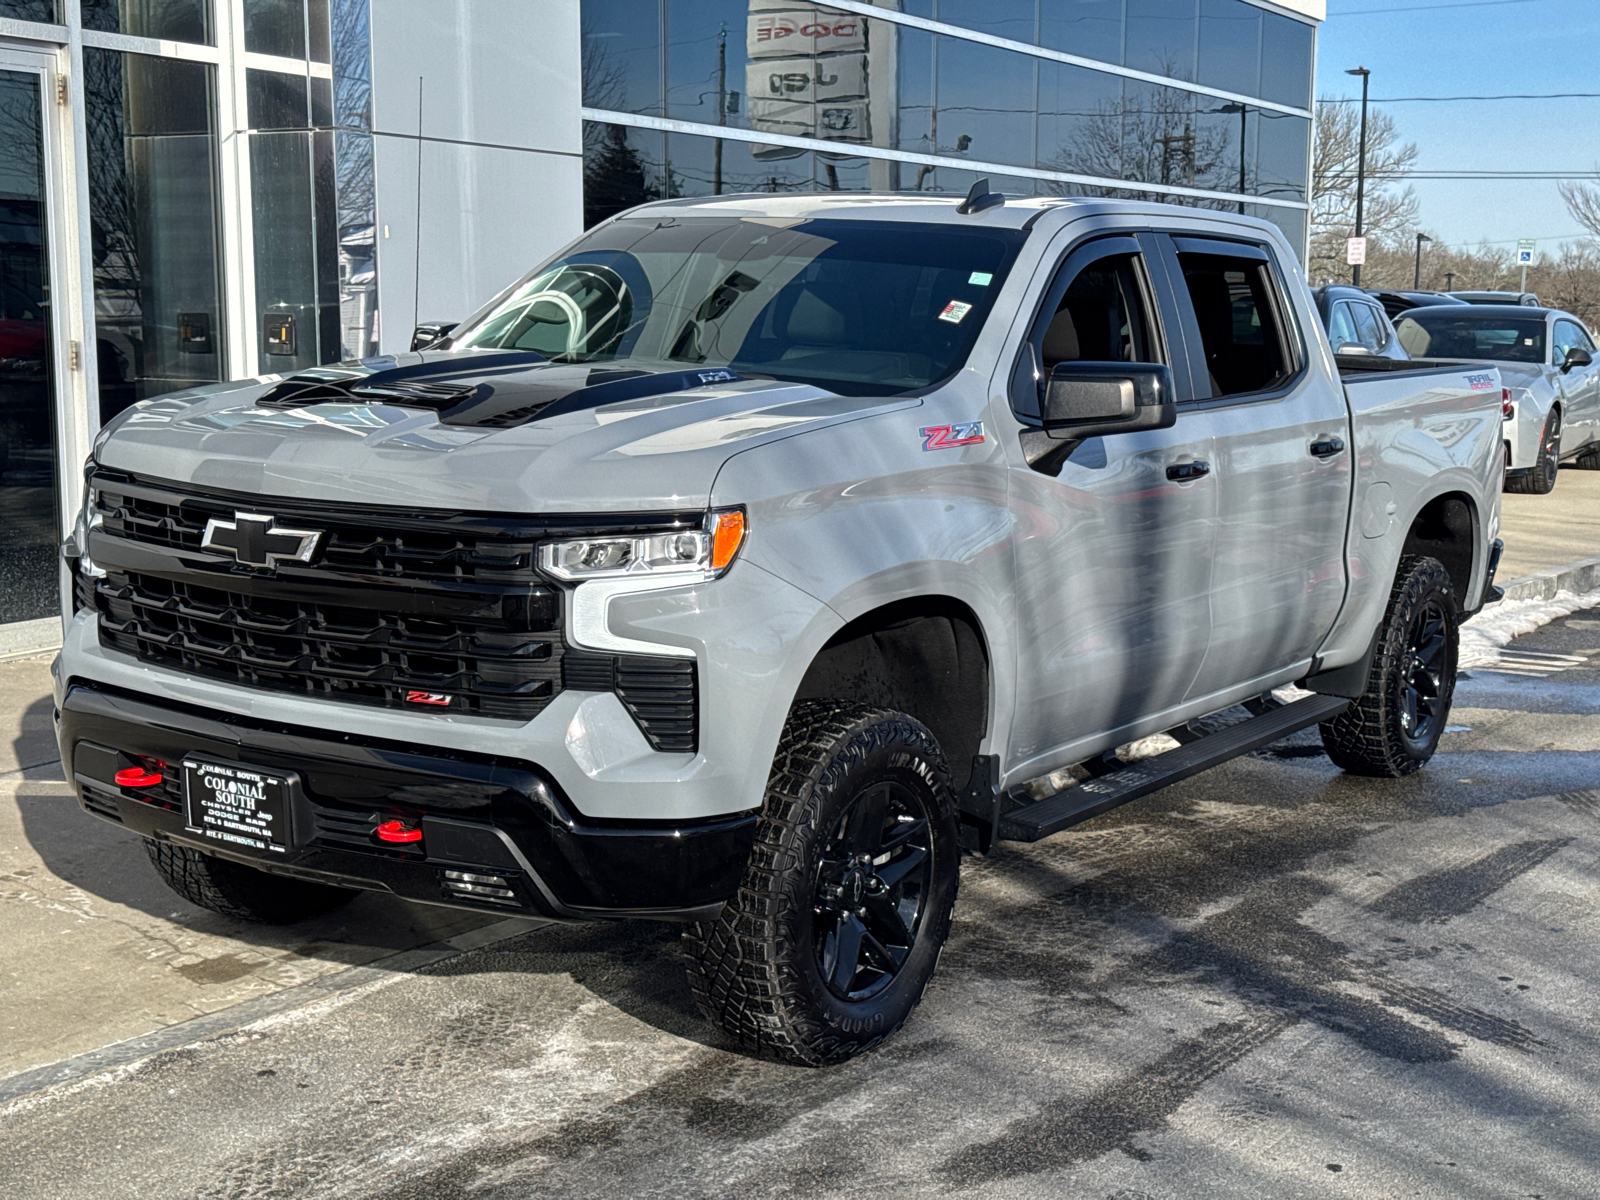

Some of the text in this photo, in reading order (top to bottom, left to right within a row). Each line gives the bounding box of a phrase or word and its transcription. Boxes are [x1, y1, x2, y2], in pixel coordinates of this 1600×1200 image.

[1463, 373, 1495, 384] TRAIL
[1470, 382, 1493, 390] BOSS
[919, 421, 985, 452] Z71
[406, 691, 452, 706] Z71
[202, 764, 234, 777] COLONIAL
[237, 771, 260, 782] SOUTH
[204, 775, 267, 800] COLONIAL
[215, 790, 256, 810] SOUTH
[201, 800, 251, 816] CHRYSLER
[208, 808, 240, 821] DODGE
[257, 810, 273, 821] Jeep
[262, 829, 272, 837] MA
